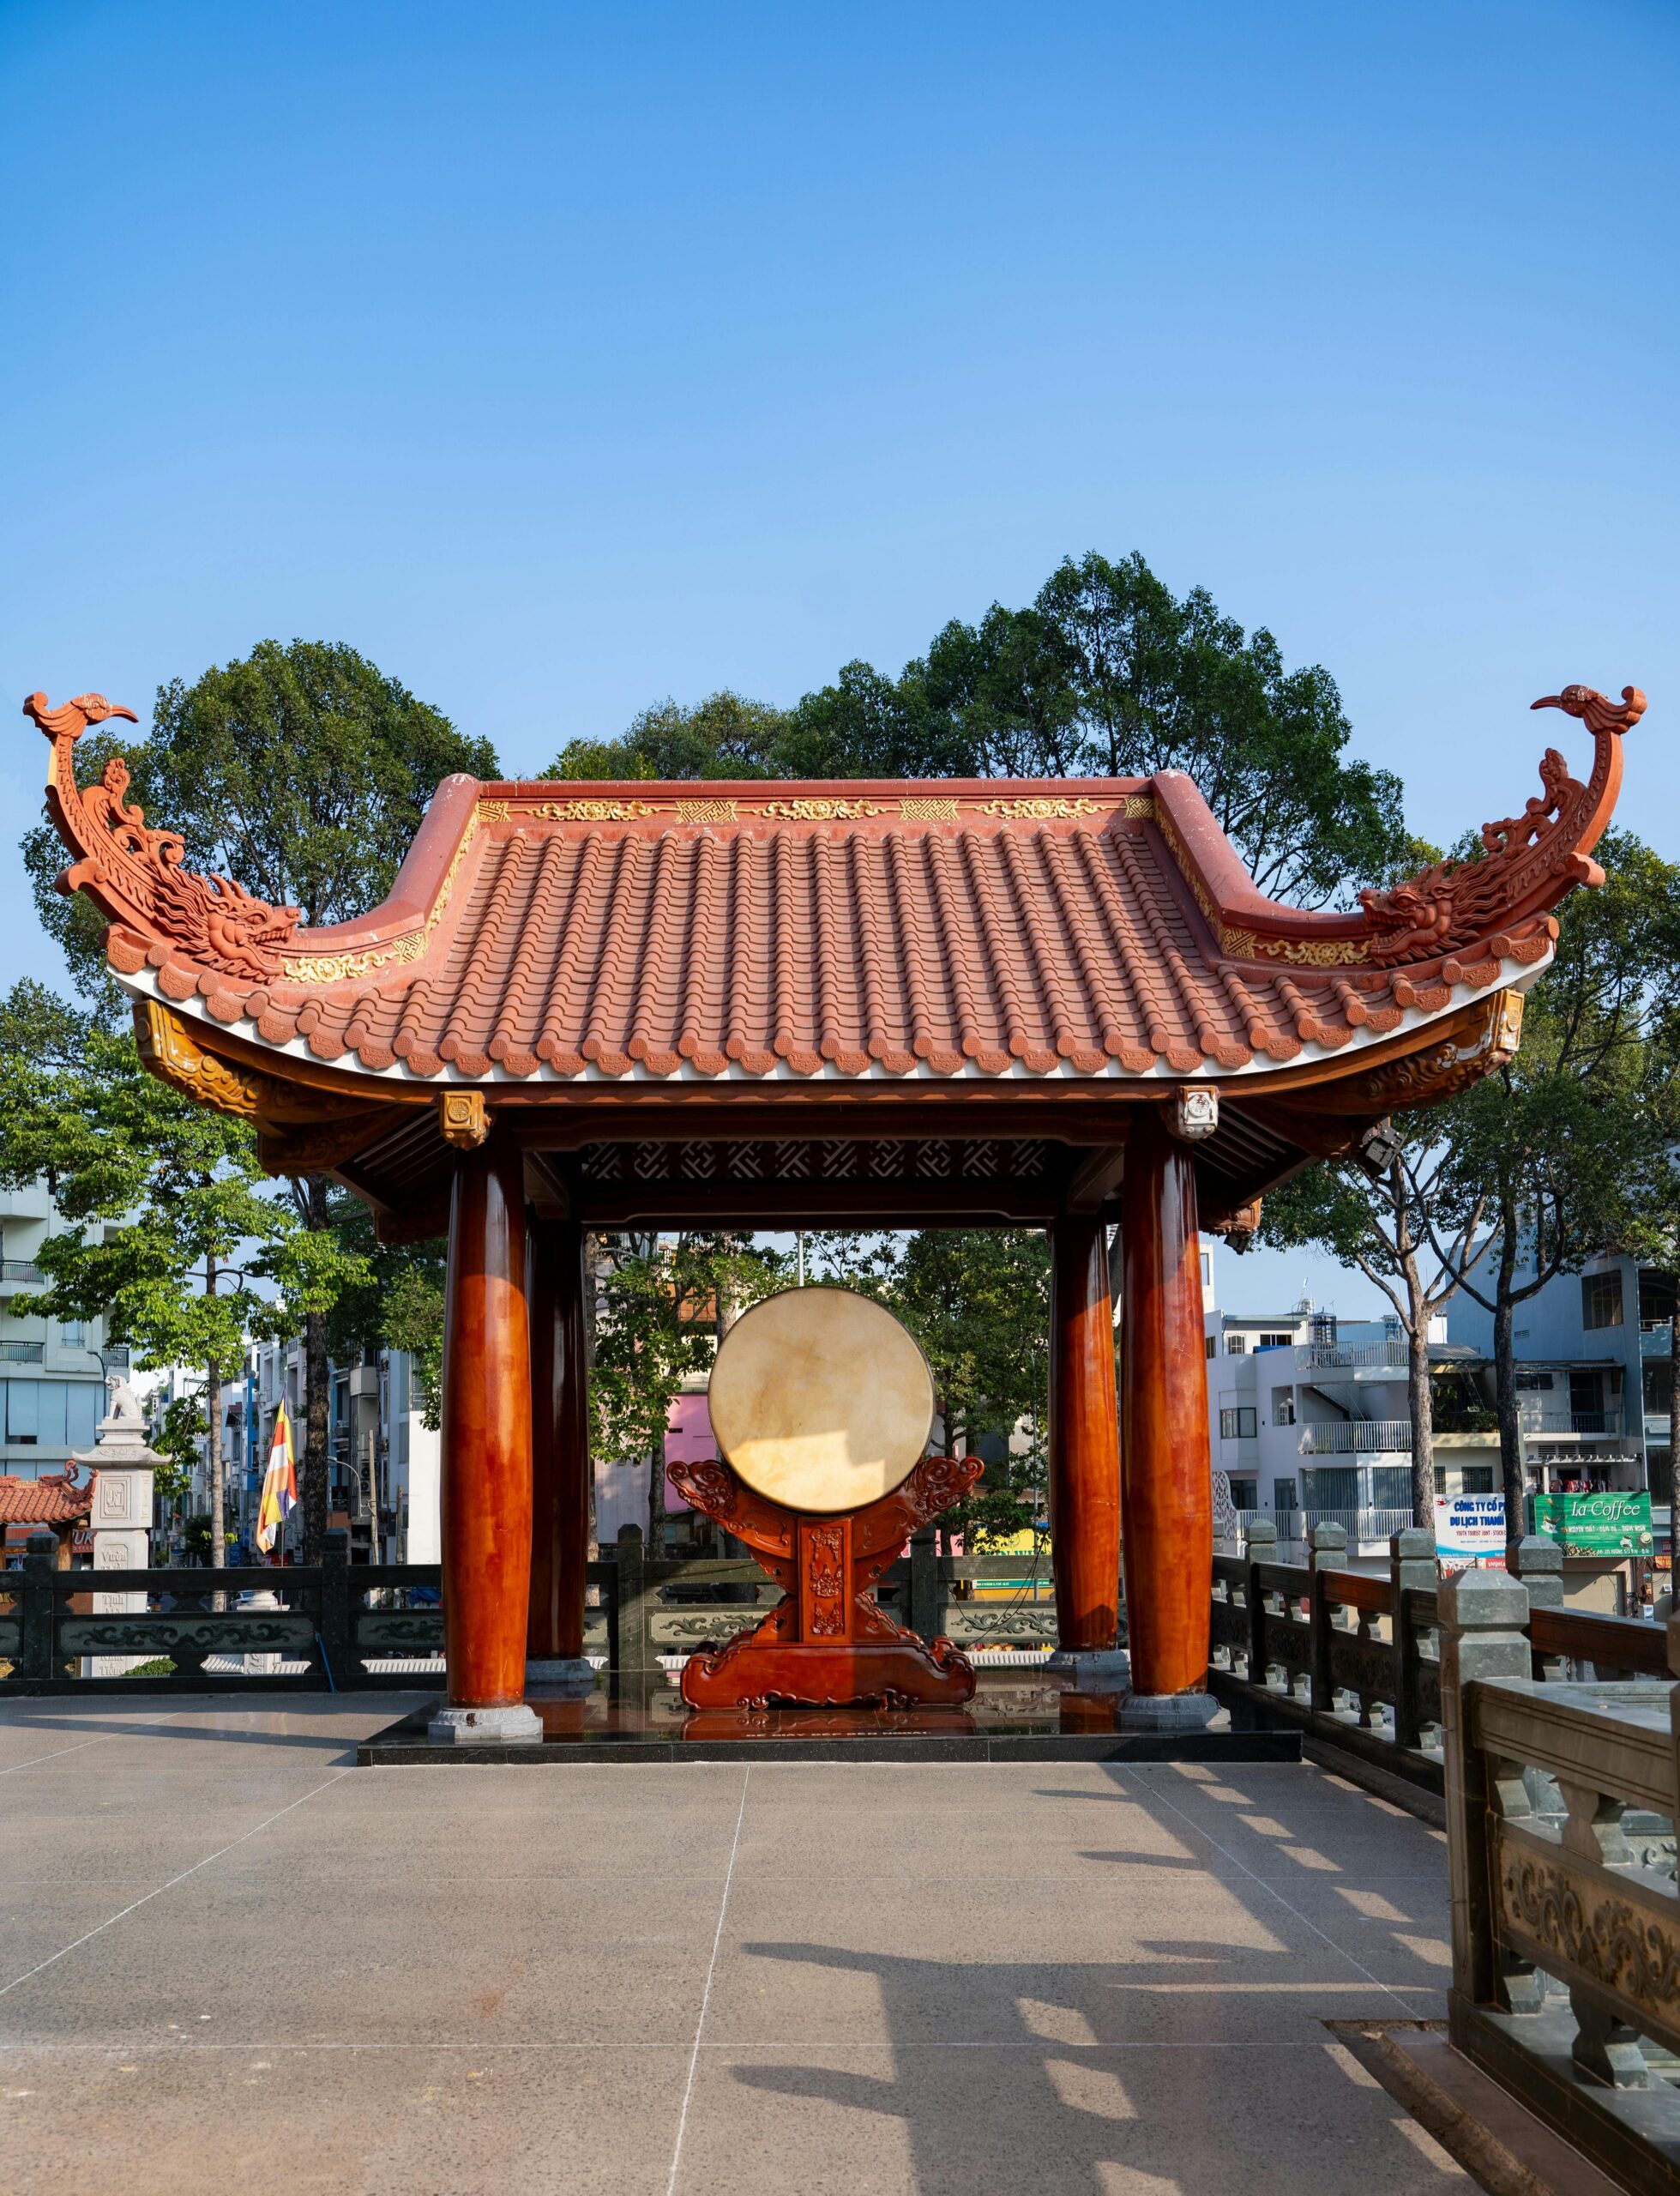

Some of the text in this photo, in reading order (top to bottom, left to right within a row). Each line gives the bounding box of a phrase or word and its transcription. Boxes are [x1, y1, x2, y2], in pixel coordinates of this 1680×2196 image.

[1454, 1500, 1474, 1511] CÔNG
[1475, 1502, 1485, 1511] TY
[1572, 1500, 1641, 1521] La Coffee
[1450, 1517, 1504, 1528] DU LỊCH THANH
